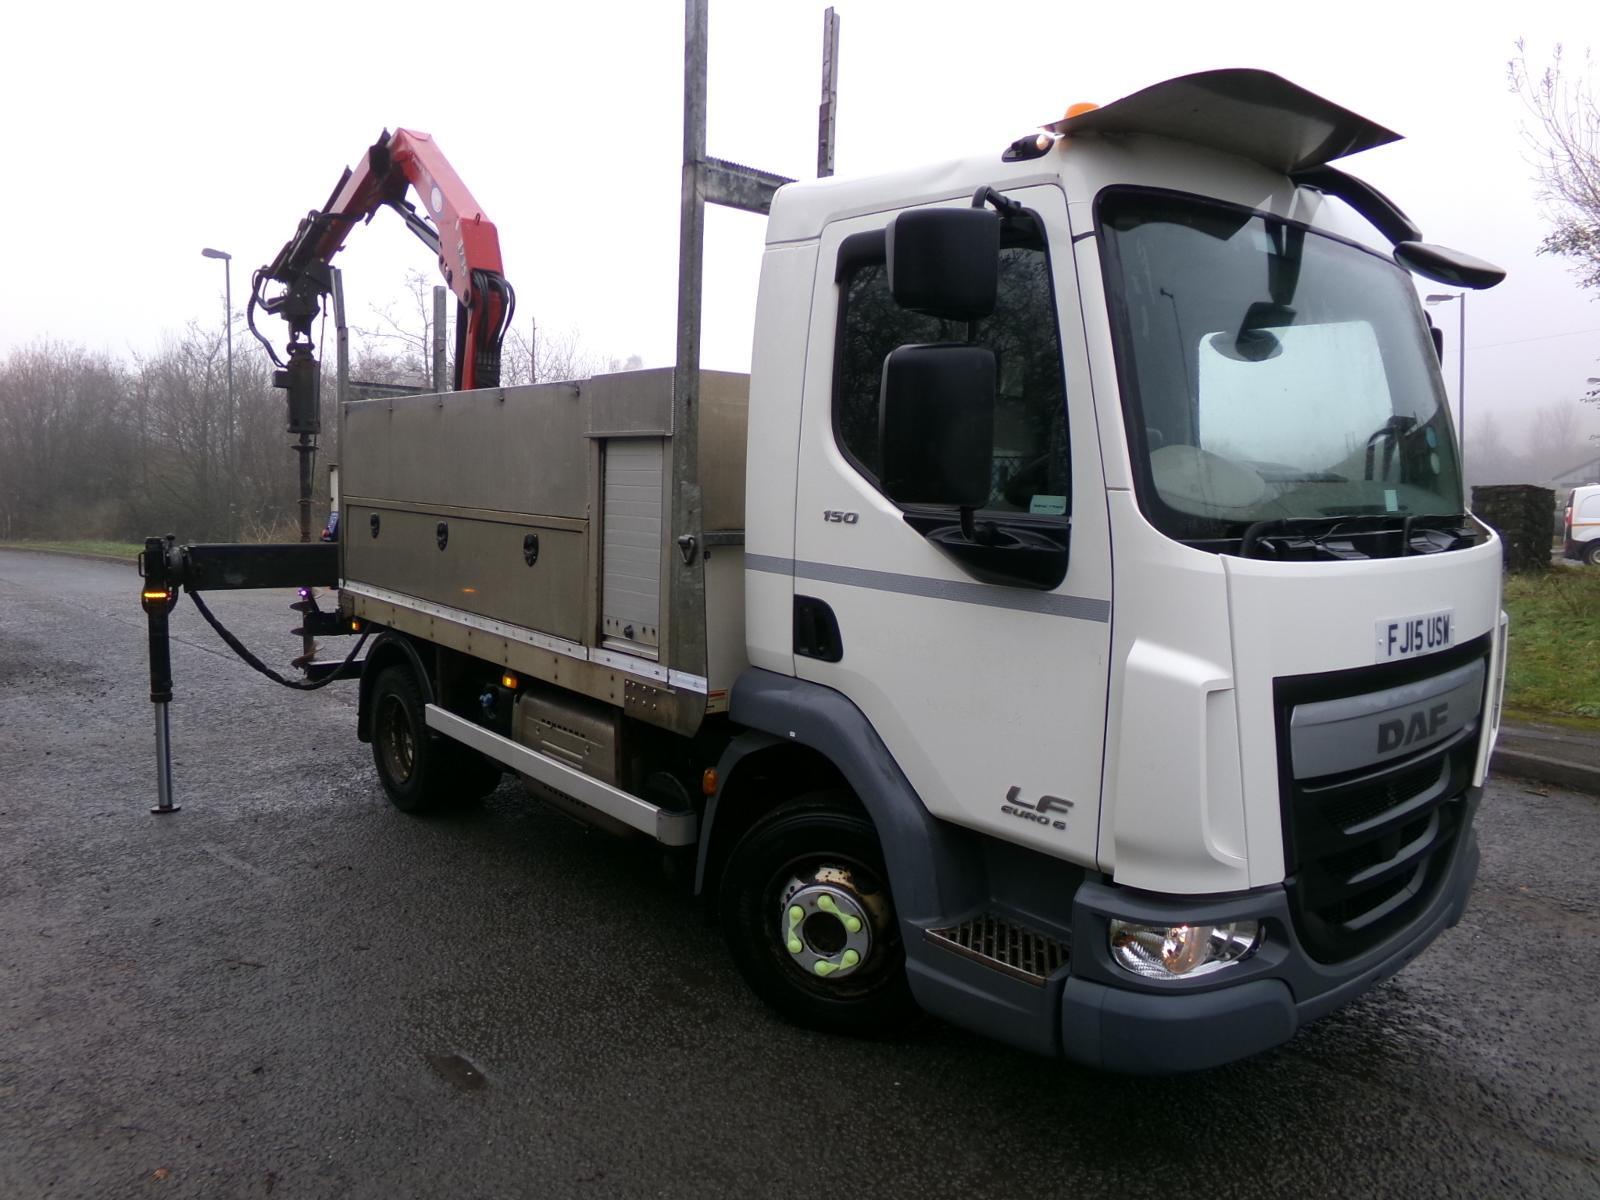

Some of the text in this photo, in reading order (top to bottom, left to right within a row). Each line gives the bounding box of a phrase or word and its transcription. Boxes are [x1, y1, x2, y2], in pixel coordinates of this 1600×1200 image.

[823, 510, 859, 524] 150
[1388, 615, 1449, 656] FJ15 USW
[1378, 703, 1448, 754] DAF
[1006, 785, 1074, 814] LF
[1001, 805, 1066, 830] EURO 6
